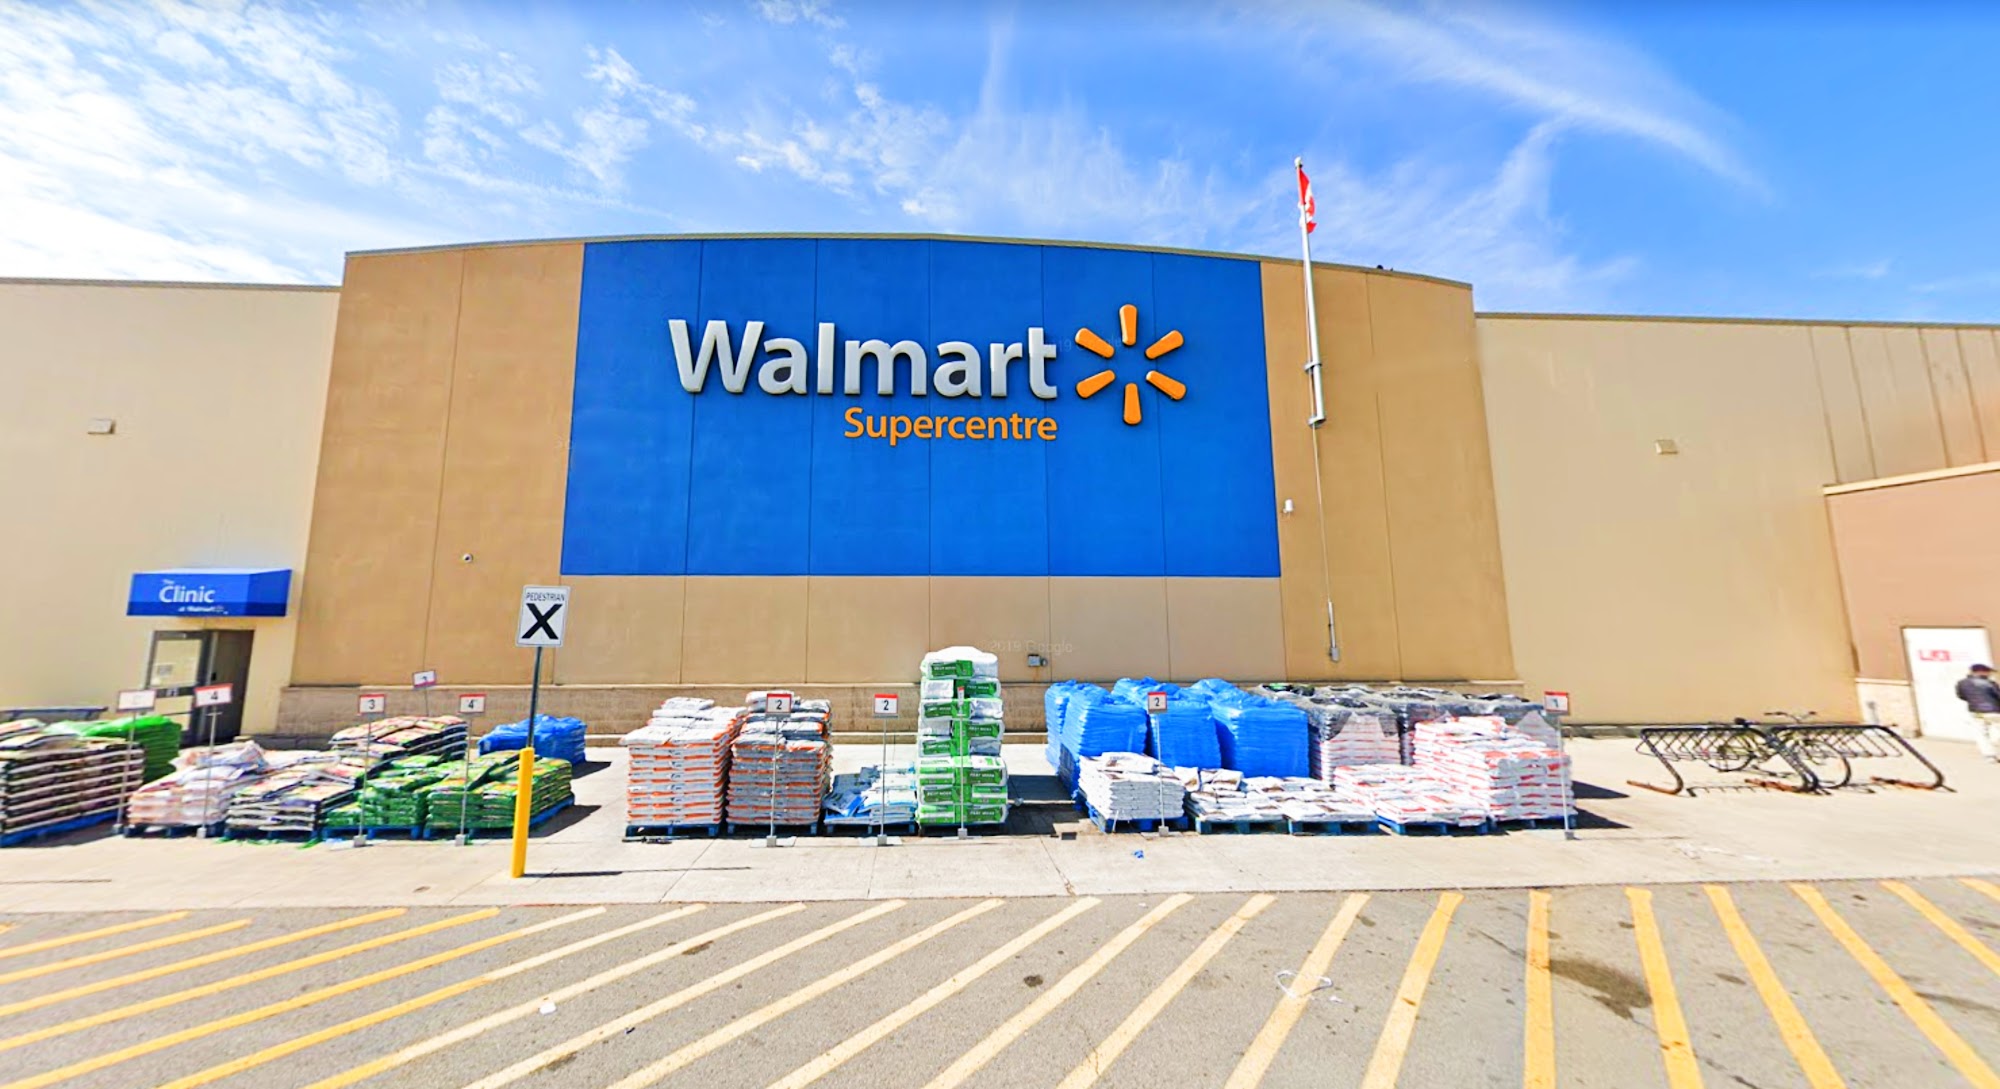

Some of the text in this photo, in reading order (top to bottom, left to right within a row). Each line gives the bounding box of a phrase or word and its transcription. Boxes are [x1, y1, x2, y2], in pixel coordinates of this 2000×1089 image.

[668, 318, 1058, 399] Walmart
[844, 405, 1057, 446] Supercentre
[159, 585, 215, 603] Clinic
[525, 592, 565, 602] PEDESTRIAN
[521, 603, 563, 640] X
[368, 699, 376, 710] 3
[467, 699, 475, 710] 4
[776, 699, 783, 710] 2
[883, 699, 889, 711] 2
[1154, 697, 1160, 706] 2
